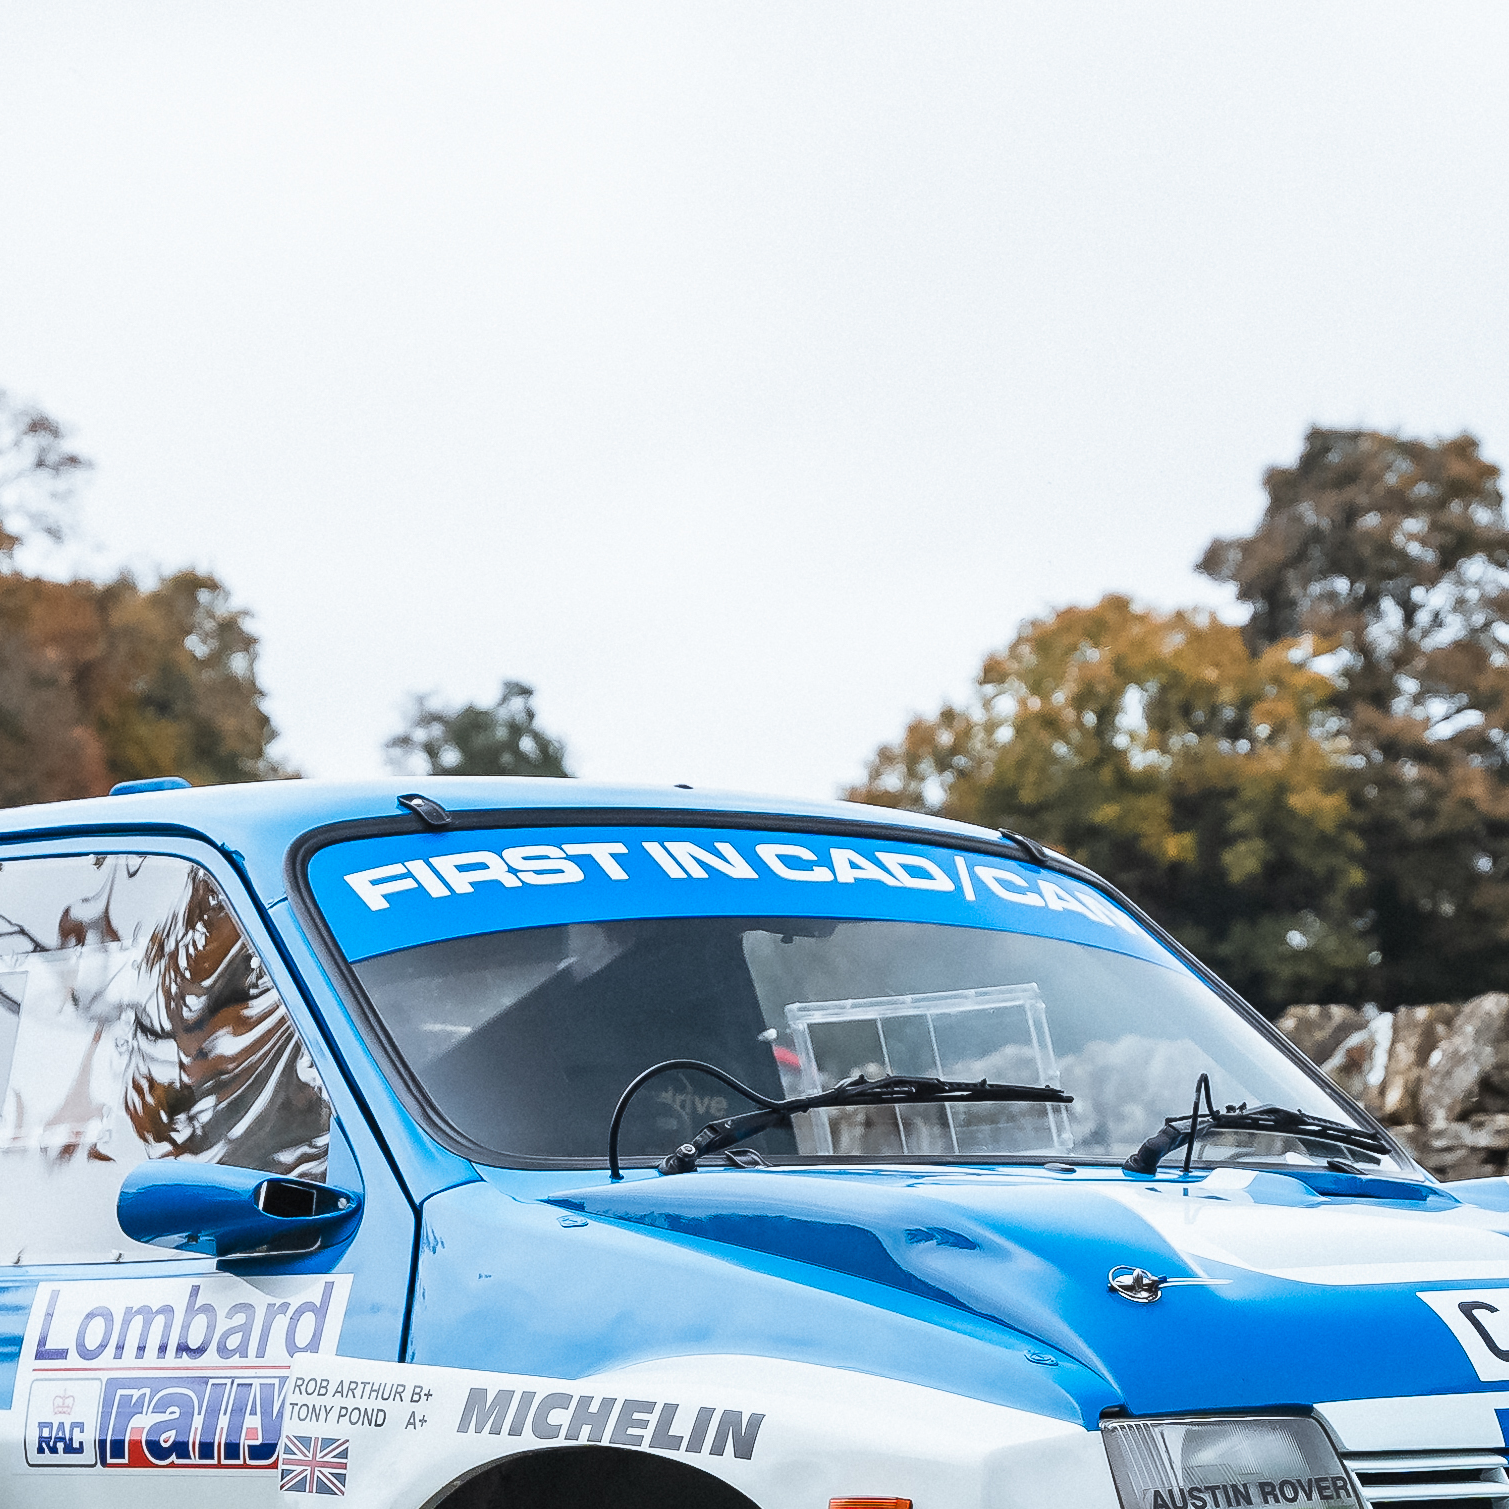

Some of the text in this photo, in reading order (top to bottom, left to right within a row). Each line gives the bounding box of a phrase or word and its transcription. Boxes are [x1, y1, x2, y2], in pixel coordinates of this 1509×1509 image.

[343, 842, 630, 911] FIRST
[641, 841, 759, 879] IN
[34, 1281, 335, 1361] Lombard
[289, 1402, 428, 1430] TONY POND A+
[292, 1377, 433, 1403] ROB ARTHUR B+
[37, 1421, 85, 1455] RAC
[107, 1376, 289, 1466] rally
[456, 1388, 765, 1461] MICHELIN
[1261, 1475, 1352, 1504] ROVER
